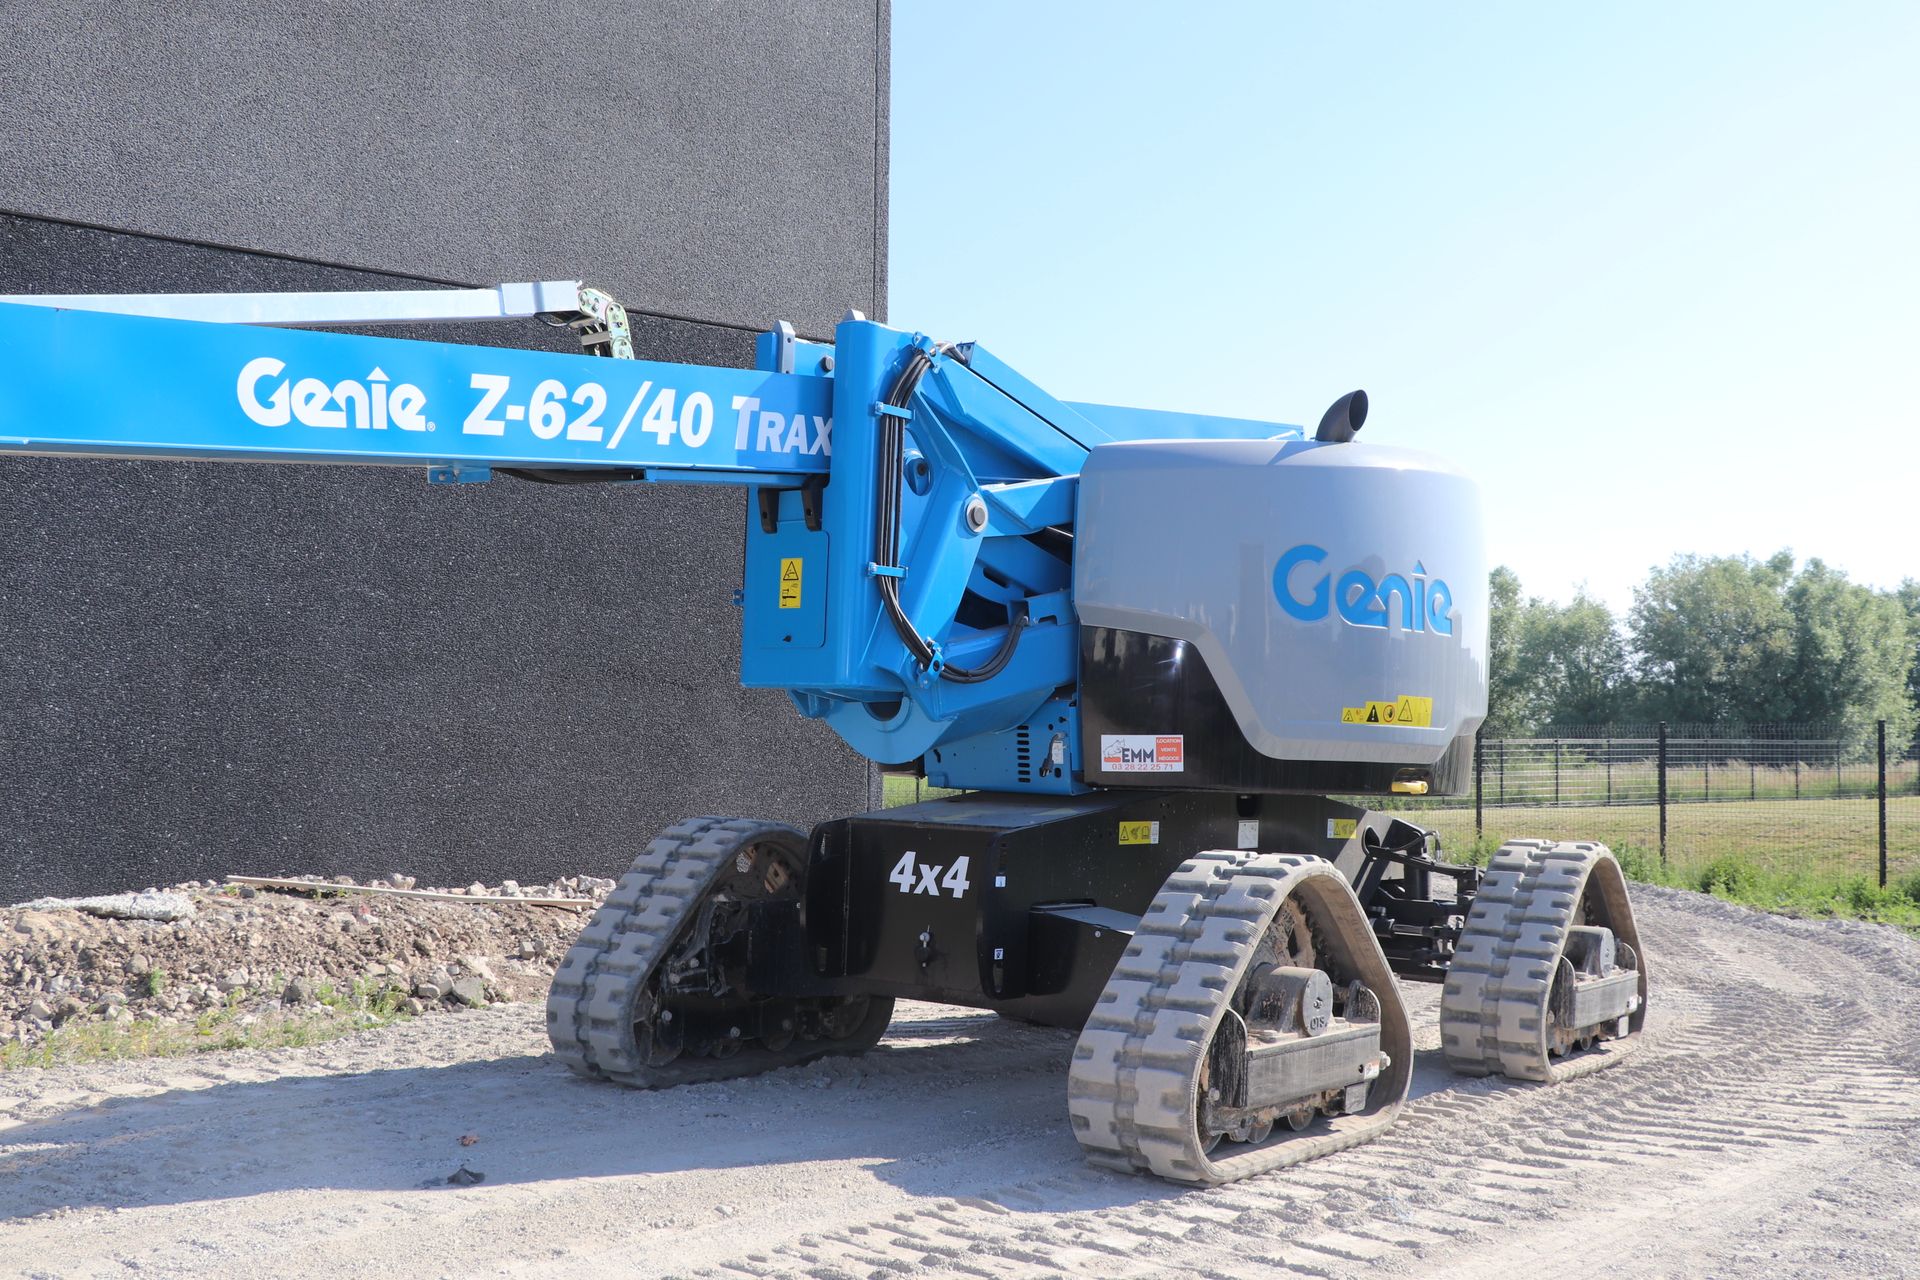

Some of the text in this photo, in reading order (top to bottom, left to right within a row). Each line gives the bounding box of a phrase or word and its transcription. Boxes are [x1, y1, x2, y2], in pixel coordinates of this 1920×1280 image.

[1272, 543, 1453, 637] Genie
[1121, 748, 1154, 762] EMM
[888, 850, 971, 899] 4x4
